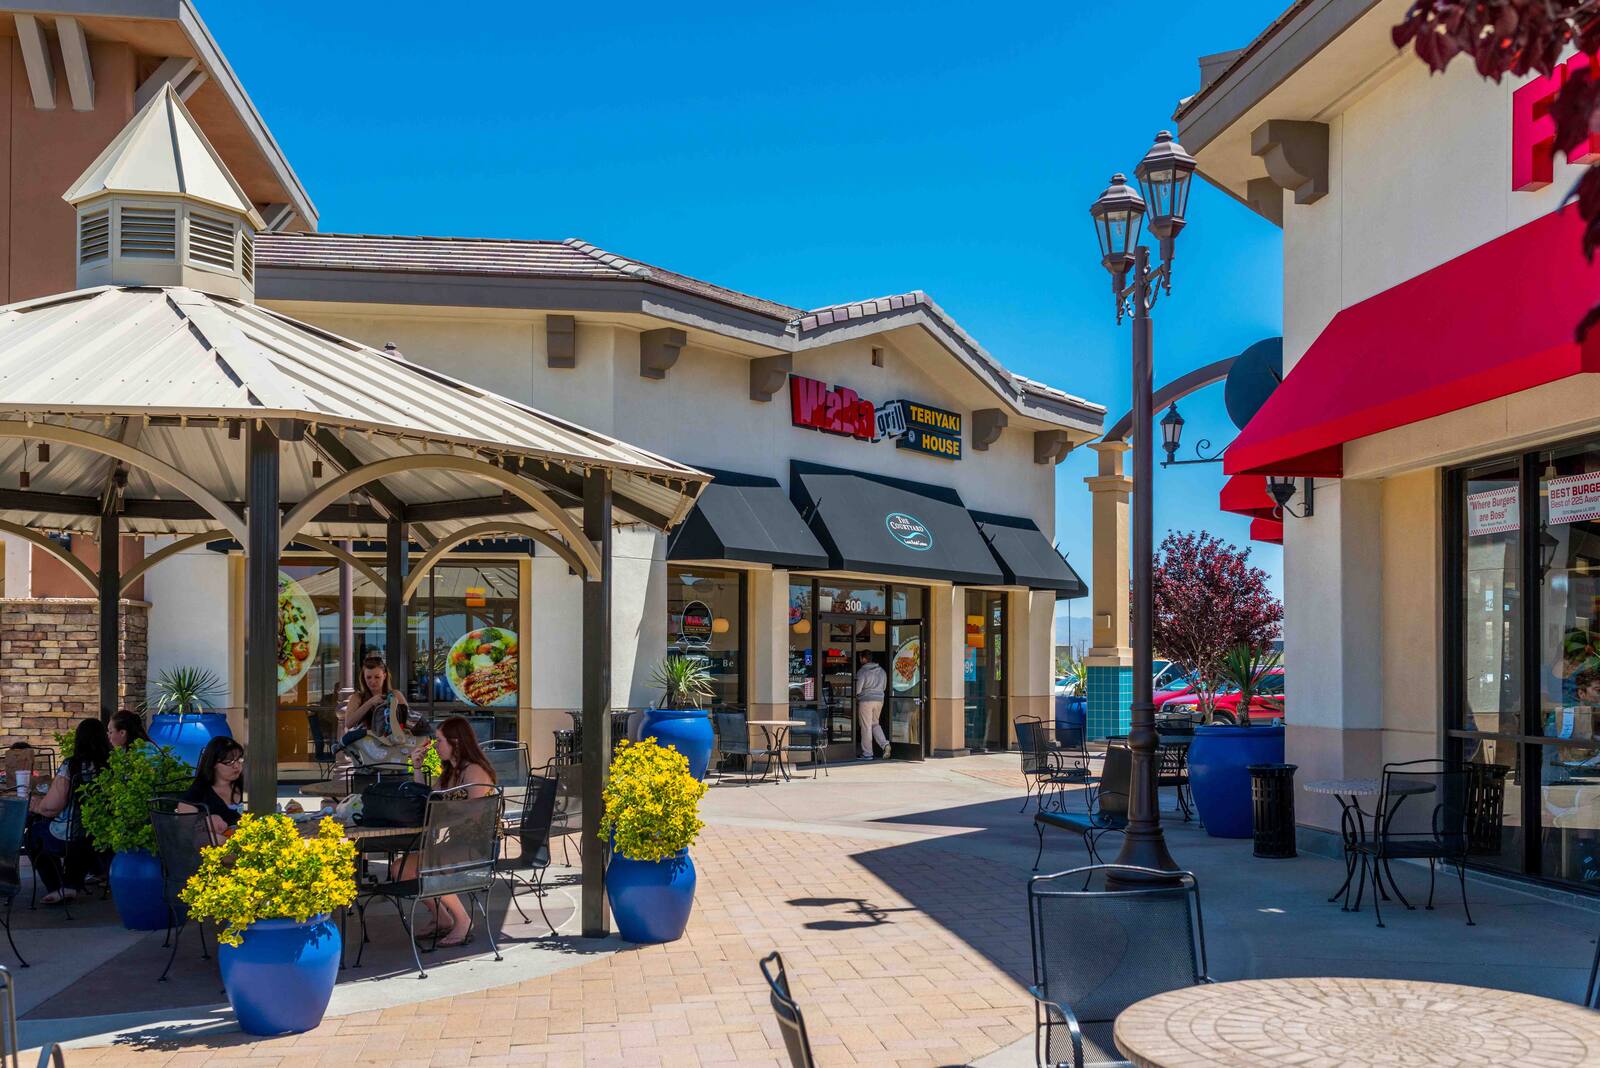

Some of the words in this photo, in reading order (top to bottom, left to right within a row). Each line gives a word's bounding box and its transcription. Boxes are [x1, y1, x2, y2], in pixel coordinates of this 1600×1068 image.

[877, 403, 905, 437] grill
[910, 405, 960, 432] TERIYAKI
[922, 433, 960, 456] HOUSE
[1550, 487, 1570, 499] BEST
[1492, 496, 1516, 508] Burgers
[1571, 496, 1584, 506] 225
[1479, 513, 1489, 522] are
[845, 600, 862, 612] 300
